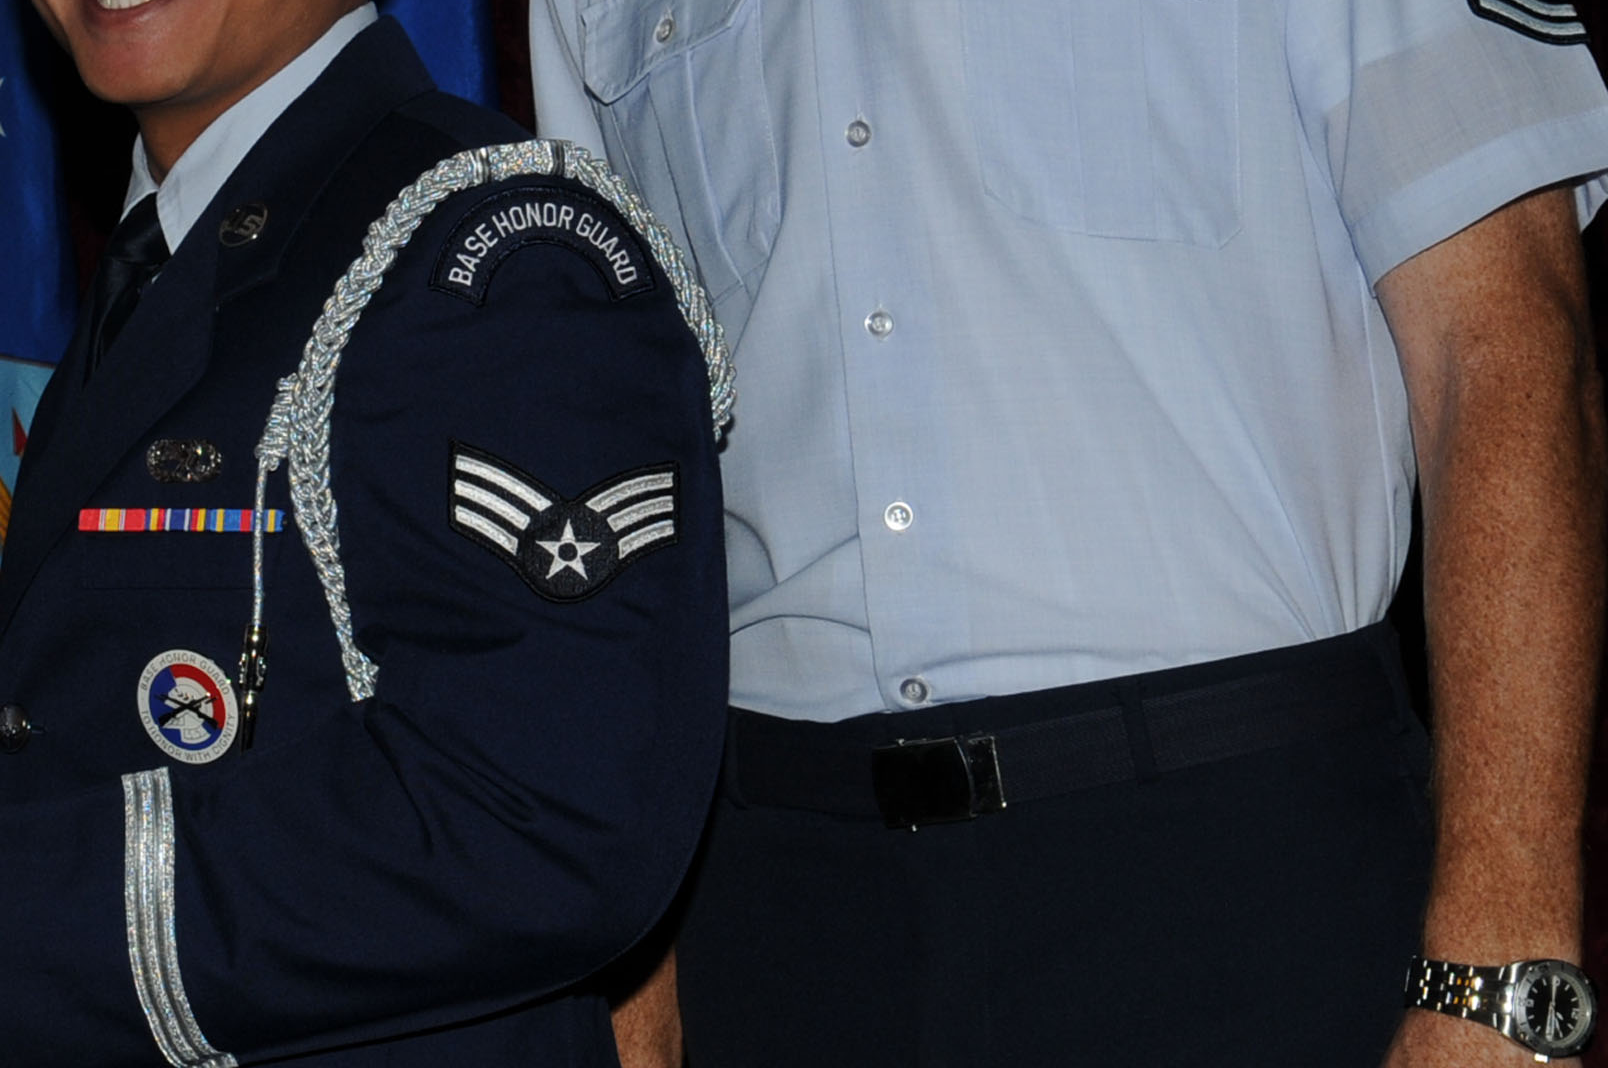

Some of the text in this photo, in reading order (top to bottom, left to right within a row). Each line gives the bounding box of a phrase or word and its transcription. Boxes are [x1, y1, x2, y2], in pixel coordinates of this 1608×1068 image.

[448, 202, 638, 286] BASE HONOR GUARD
[140, 653, 230, 695] BASE HONOR GUARD
[185, 750, 212, 762] WITH
